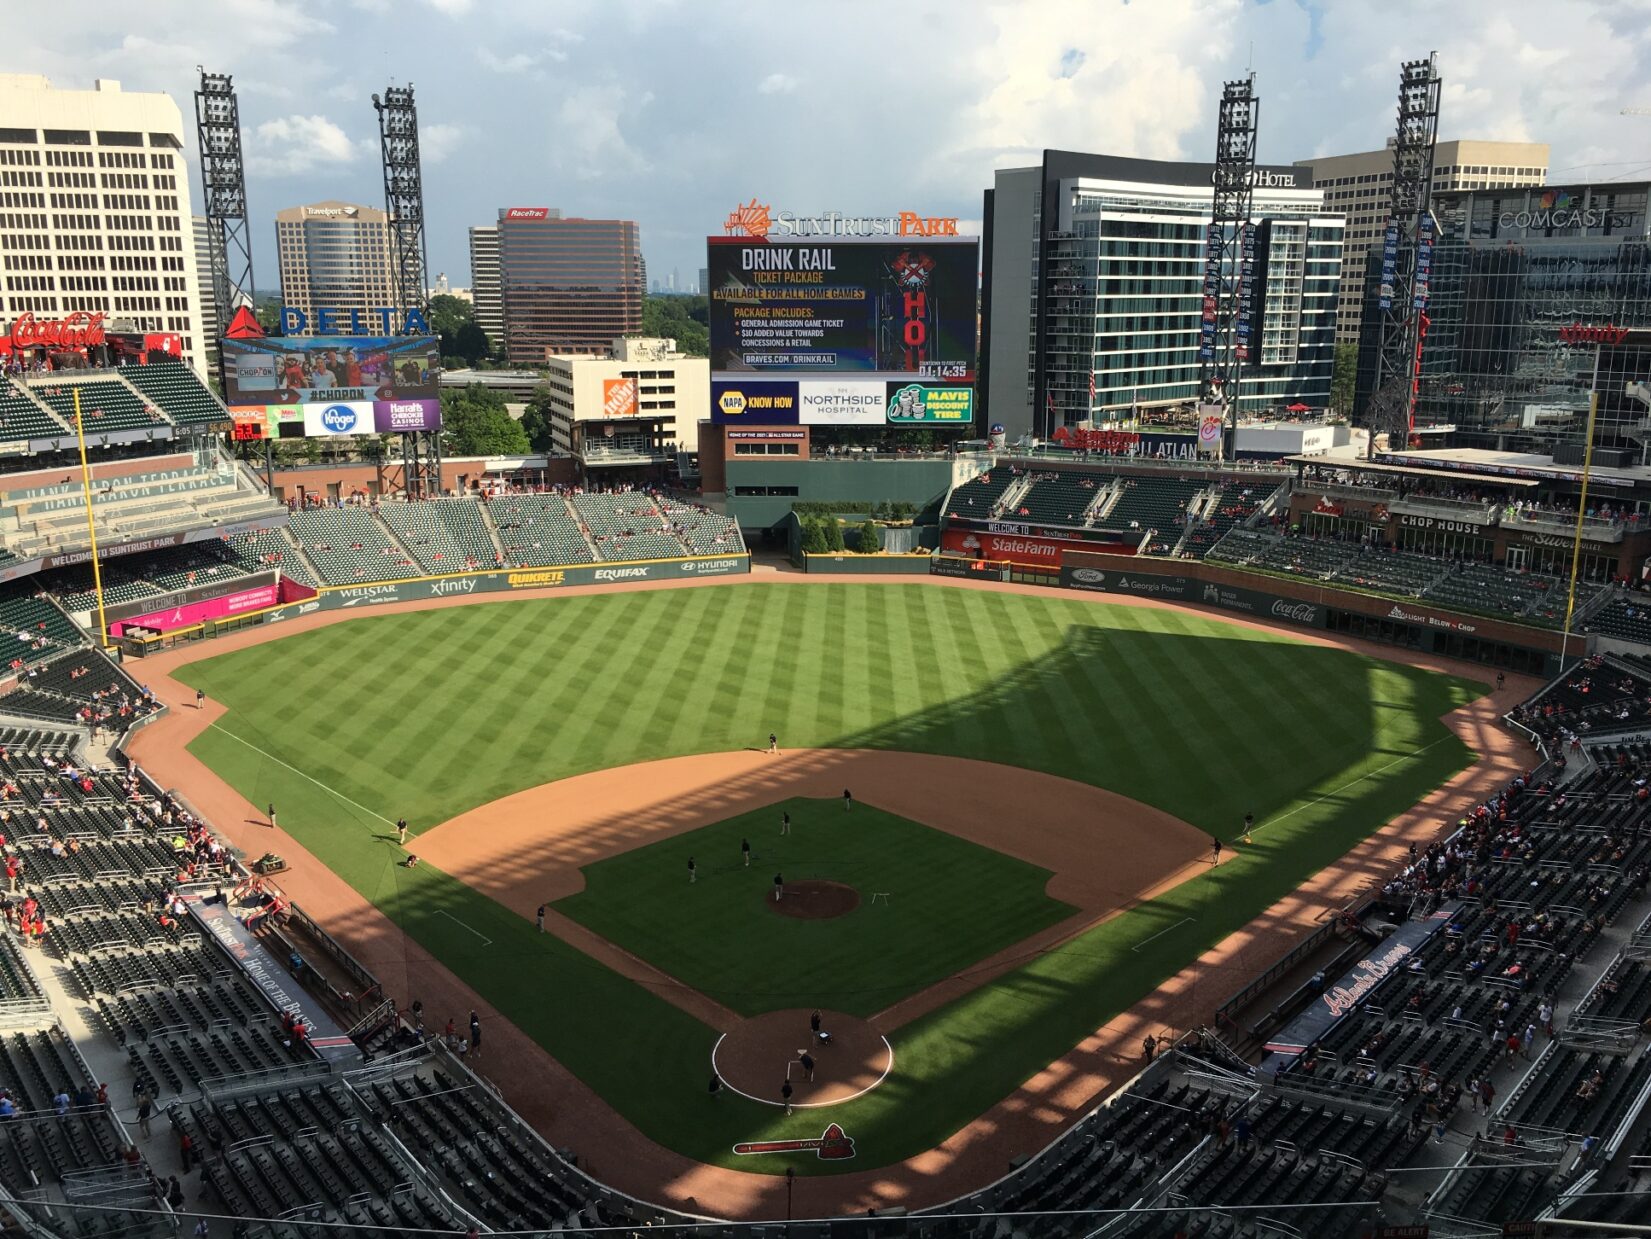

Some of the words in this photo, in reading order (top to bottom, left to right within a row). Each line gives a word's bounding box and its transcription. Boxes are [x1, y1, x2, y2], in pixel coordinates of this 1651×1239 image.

[1258, 171, 1296, 186] HOTEL
[307, 208, 341, 216] Travelport
[899, 211, 959, 237] PARK
[1499, 208, 1610, 229] COMCAST
[742, 249, 793, 270] DRINK
[799, 249, 836, 270] RAIL
[754, 272, 782, 284] TICKET
[784, 272, 824, 284] PACKAGE
[716, 288, 763, 299] AVAILABLE
[766, 288, 783, 298] FOR
[786, 288, 802, 298] ALL
[803, 288, 828, 298] HOME
[831, 288, 863, 298] GAMES
[734, 308, 770, 318] PACKAGE
[772, 308, 814, 318] INCLUDES:
[281, 307, 430, 335] DELTA
[239, 368, 258, 376] CHOP
[262, 368, 272, 376] ON
[919, 366, 966, 377] 01:14:35
[310, 389, 366, 400] #CHOPON
[604, 378, 634, 414] HOME
[804, 396, 882, 405] NORTHSIDE
[926, 392, 969, 400] MAVIS
[724, 398, 742, 408] NAPA
[748, 398, 772, 408] KNOW
[774, 398, 792, 408] HOW
[325, 408, 355, 430] Kroger
[176, 428, 190, 436] 6:05
[1158, 442, 1198, 460] ATLAN
[989, 523, 1019, 534] WELCOME
[1021, 526, 1029, 534] TO
[1401, 515, 1434, 528] CHOP
[1438, 520, 1480, 535] HOUSE
[1522, 534, 1534, 542] THE
[51, 551, 94, 567] WELCOME
[96, 549, 108, 561] TO
[109, 540, 152, 558] SUNTRUST
[154, 536, 176, 548] PARK
[698, 560, 738, 569] HYUNDAI
[508, 572, 564, 584] QUIKRETE
[595, 568, 648, 580] EQUIFAX
[1078, 570, 1098, 582] Ford
[340, 584, 396, 598] WELLSTAR
[431, 578, 476, 596] xfinity
[1131, 580, 1160, 592] Georgia
[1161, 584, 1184, 593] Power
[141, 596, 176, 612] WELCOME
[178, 594, 187, 604] TO
[244, 958, 268, 982] HOME
[271, 988, 291, 1009] THE
